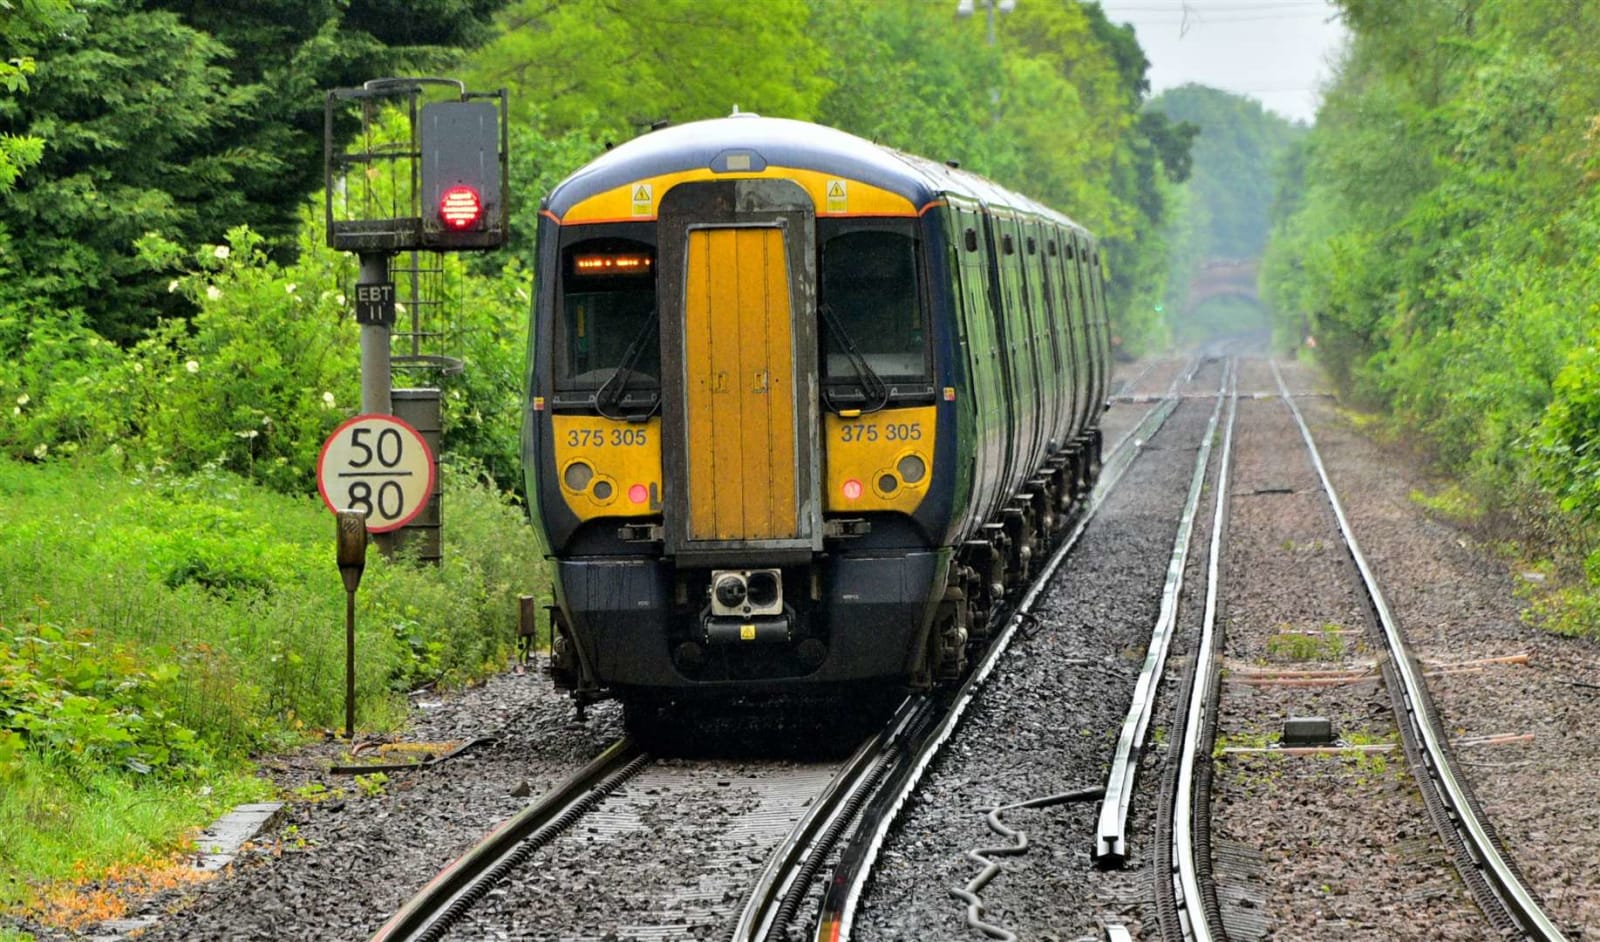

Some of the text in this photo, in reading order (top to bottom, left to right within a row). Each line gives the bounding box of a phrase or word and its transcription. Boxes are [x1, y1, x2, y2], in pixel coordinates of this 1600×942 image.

[358, 286, 392, 302] EBT
[370, 305, 382, 320] 11
[567, 428, 647, 447] 375 305
[841, 423, 922, 442] 375 305
[348, 428, 403, 468] 50
[347, 481, 404, 520] 80
